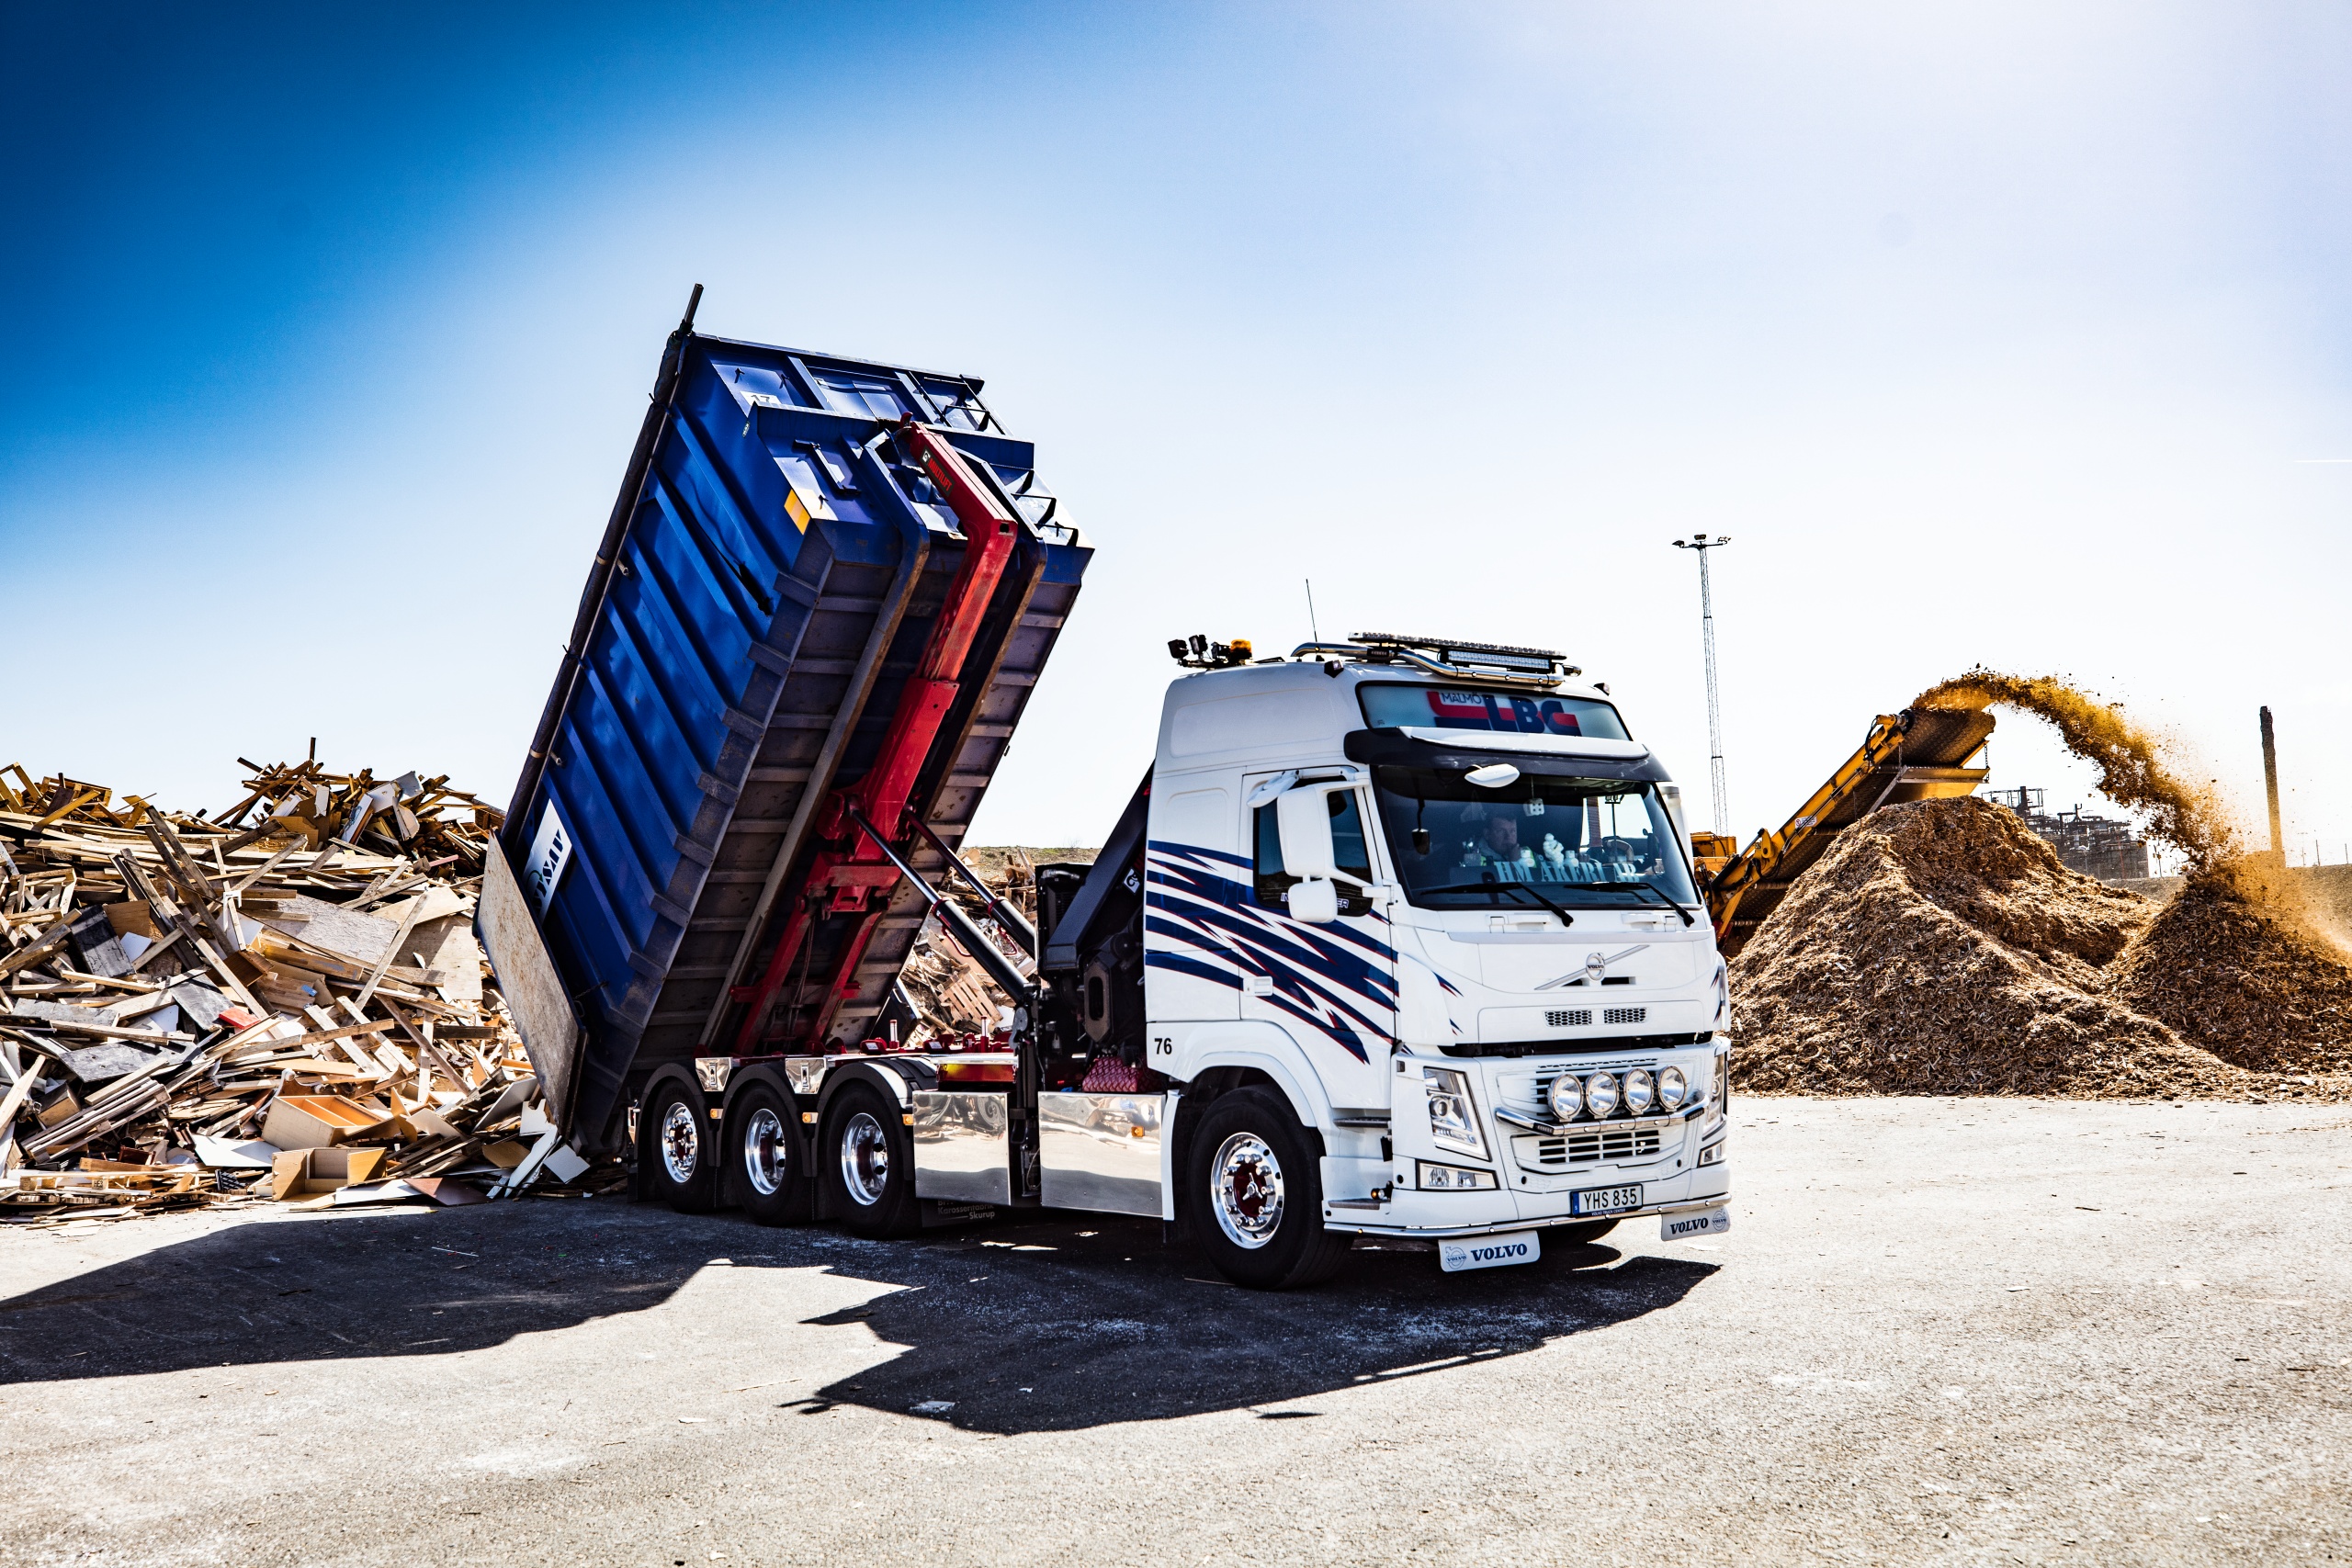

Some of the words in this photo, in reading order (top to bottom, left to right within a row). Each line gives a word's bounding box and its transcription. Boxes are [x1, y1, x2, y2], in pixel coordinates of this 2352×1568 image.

[928, 457, 953, 491] MULTILIFT
[1442, 691, 1482, 705] MALMÖ
[1494, 861, 1534, 883] HM
[1612, 862, 1640, 883] AB
[1154, 1037, 1172, 1055] 76
[1584, 1191, 1609, 1210] YHS
[1612, 1188, 1637, 1206] 835
[968, 1212, 995, 1220] Skurup
[1670, 1217, 1709, 1235] VOLVO
[1470, 1243, 1528, 1262] VOLVO
